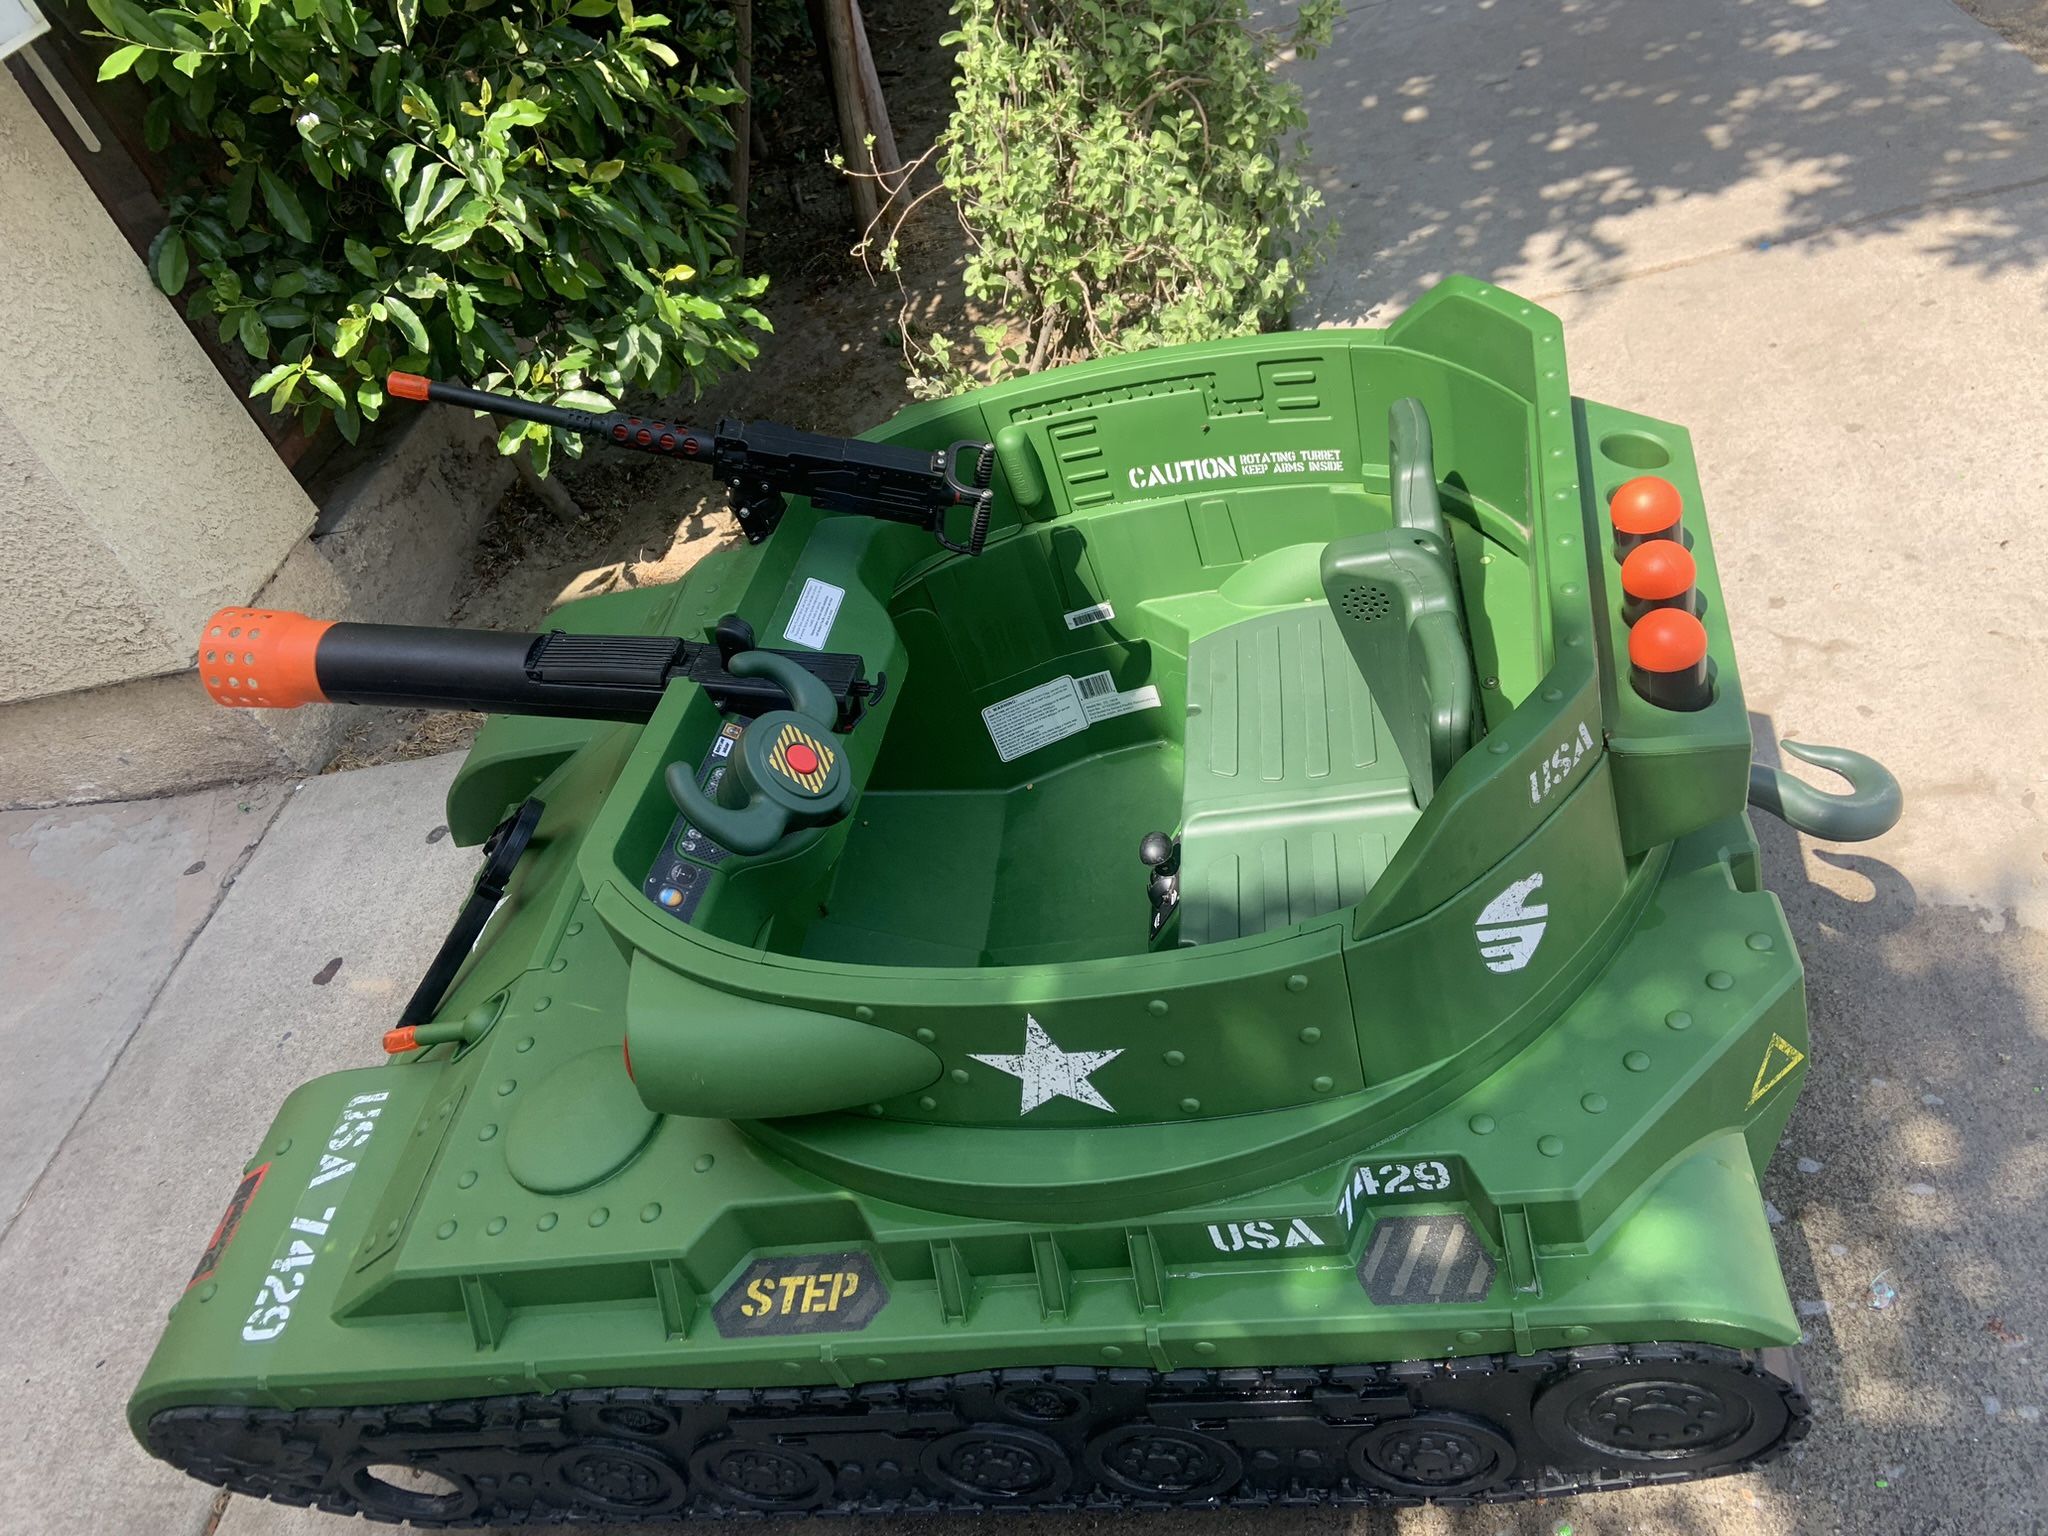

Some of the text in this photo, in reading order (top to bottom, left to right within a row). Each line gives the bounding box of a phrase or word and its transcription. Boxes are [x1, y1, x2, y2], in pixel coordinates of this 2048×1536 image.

[1128, 456, 1238, 489] CAUTION
[1239, 449, 1341, 464] ROTATING TURRET
[1241, 460, 1344, 475] KEEP ARMS INSIDE
[1529, 721, 1594, 804] USA
[242, 1091, 389, 1341] USA 7429
[1207, 1218, 1325, 1252] USA
[741, 1272, 859, 1317] STEP
